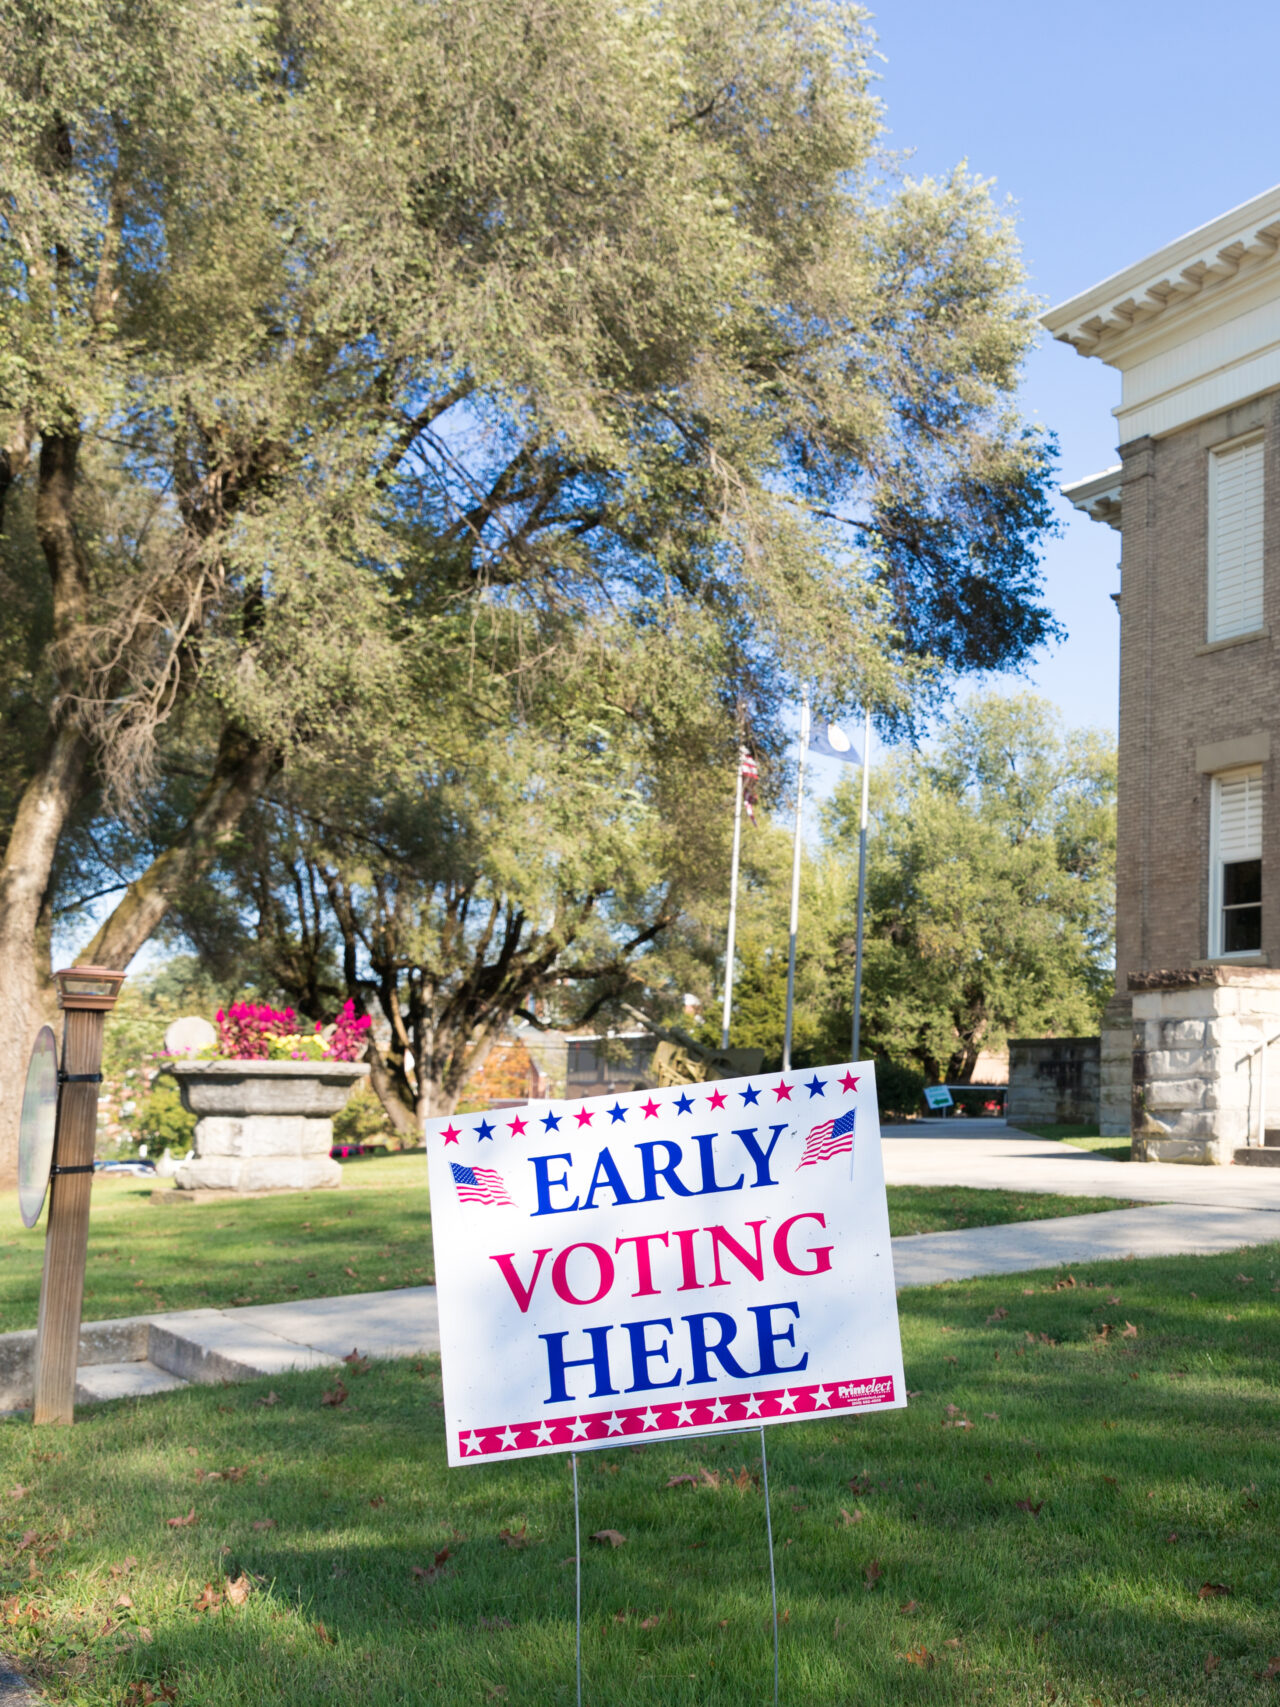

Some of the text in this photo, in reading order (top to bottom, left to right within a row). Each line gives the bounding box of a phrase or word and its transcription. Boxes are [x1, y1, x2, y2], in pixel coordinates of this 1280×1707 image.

[528, 1123, 789, 1217] EARLY
[489, 1212, 835, 1314] VOTING
[538, 1301, 809, 1405] HERE
[838, 1378, 892, 1397] Printelect
